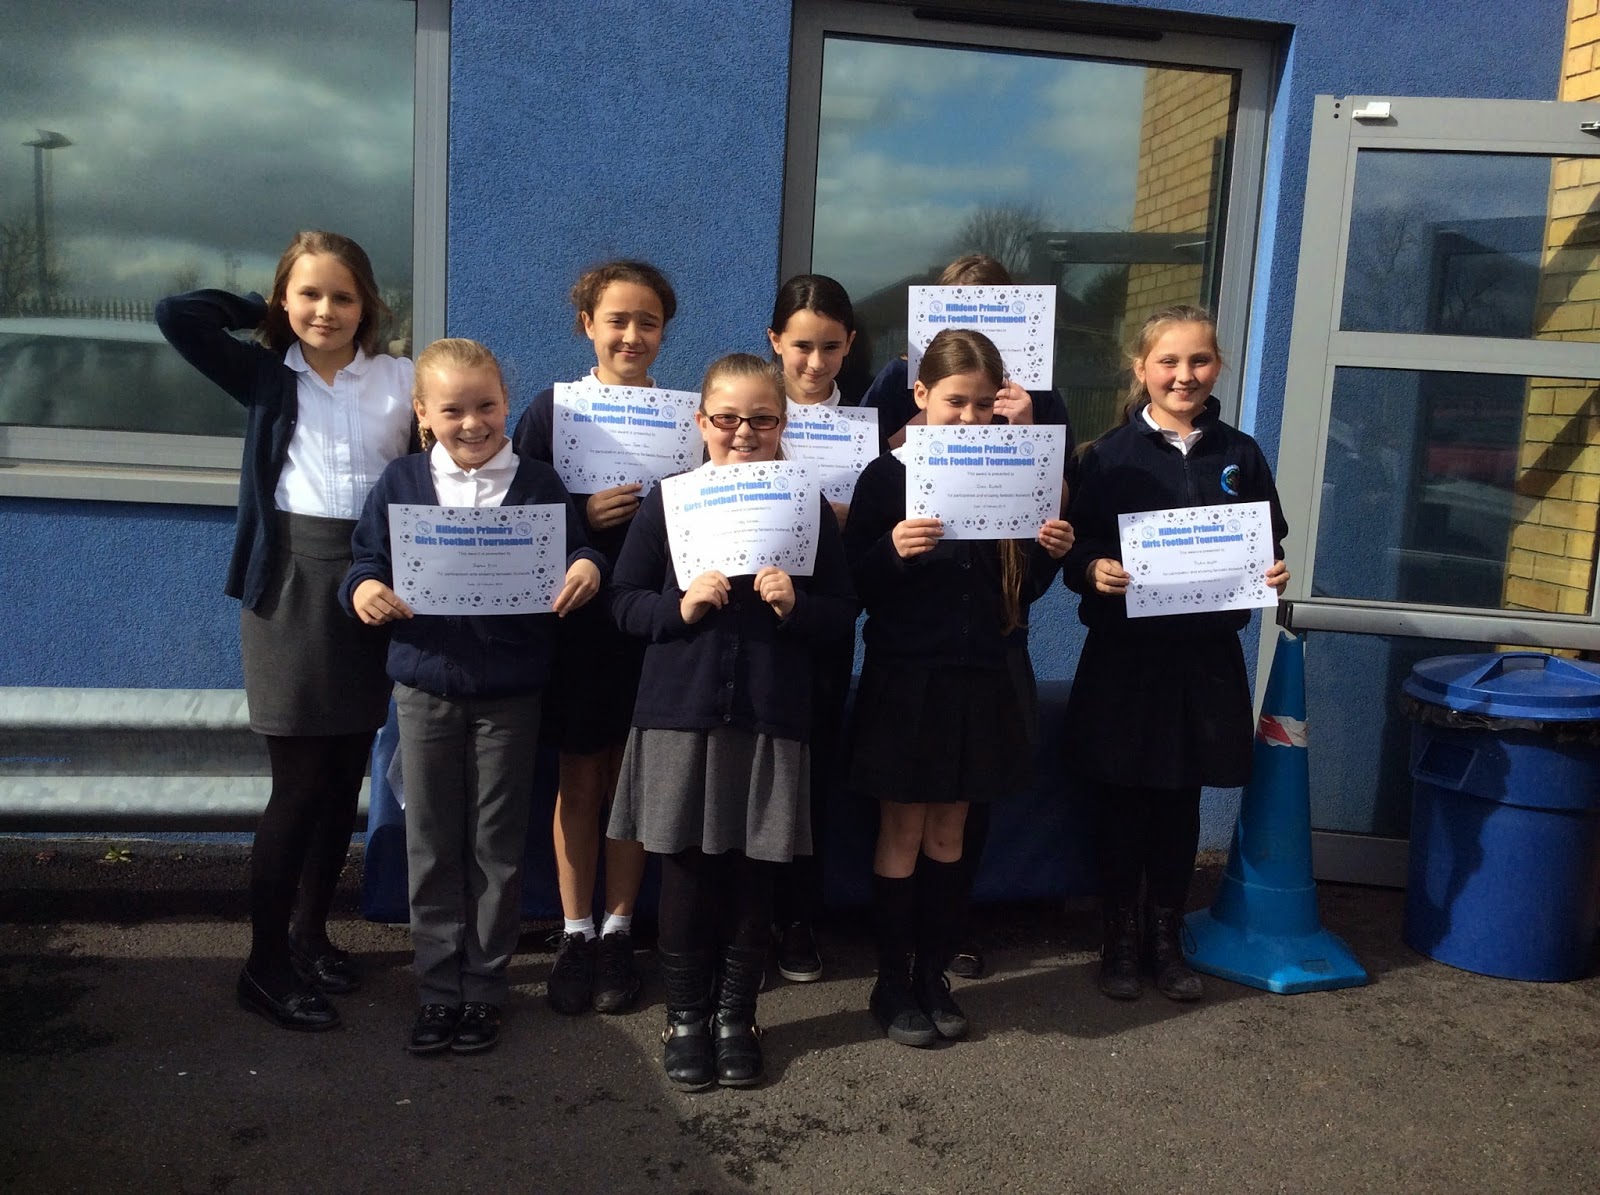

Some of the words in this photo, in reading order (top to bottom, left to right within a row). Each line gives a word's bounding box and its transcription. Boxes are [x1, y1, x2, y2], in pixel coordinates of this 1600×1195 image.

[979, 303, 1010, 313] Primary
[928, 314, 947, 323] Girls
[947, 314, 978, 323] Football
[980, 314, 1026, 323] Tournament
[627, 405, 660, 417] Primary
[573, 413, 592, 422] Girls
[593, 415, 626, 425] Football
[628, 417, 677, 430] Tournament
[805, 421, 835, 431] Primary
[806, 432, 851, 441] Tournament
[984, 445, 1017, 455] Primary
[928, 457, 949, 466] Girls
[950, 456, 983, 466] Football
[985, 457, 1035, 466] Tournament
[737, 481, 772, 490] Primary
[684, 502, 702, 512] Girls
[703, 494, 737, 507] Football
[739, 492, 792, 503] Tournament
[476, 526, 513, 535] Primary
[1193, 524, 1225, 533] Primary
[415, 535, 437, 545] Girls
[439, 537, 476, 546] Football
[478, 537, 533, 546] Tournament
[1141, 539, 1161, 549] Girls
[1162, 536, 1194, 547] Football
[1195, 533, 1243, 544] Tournament
